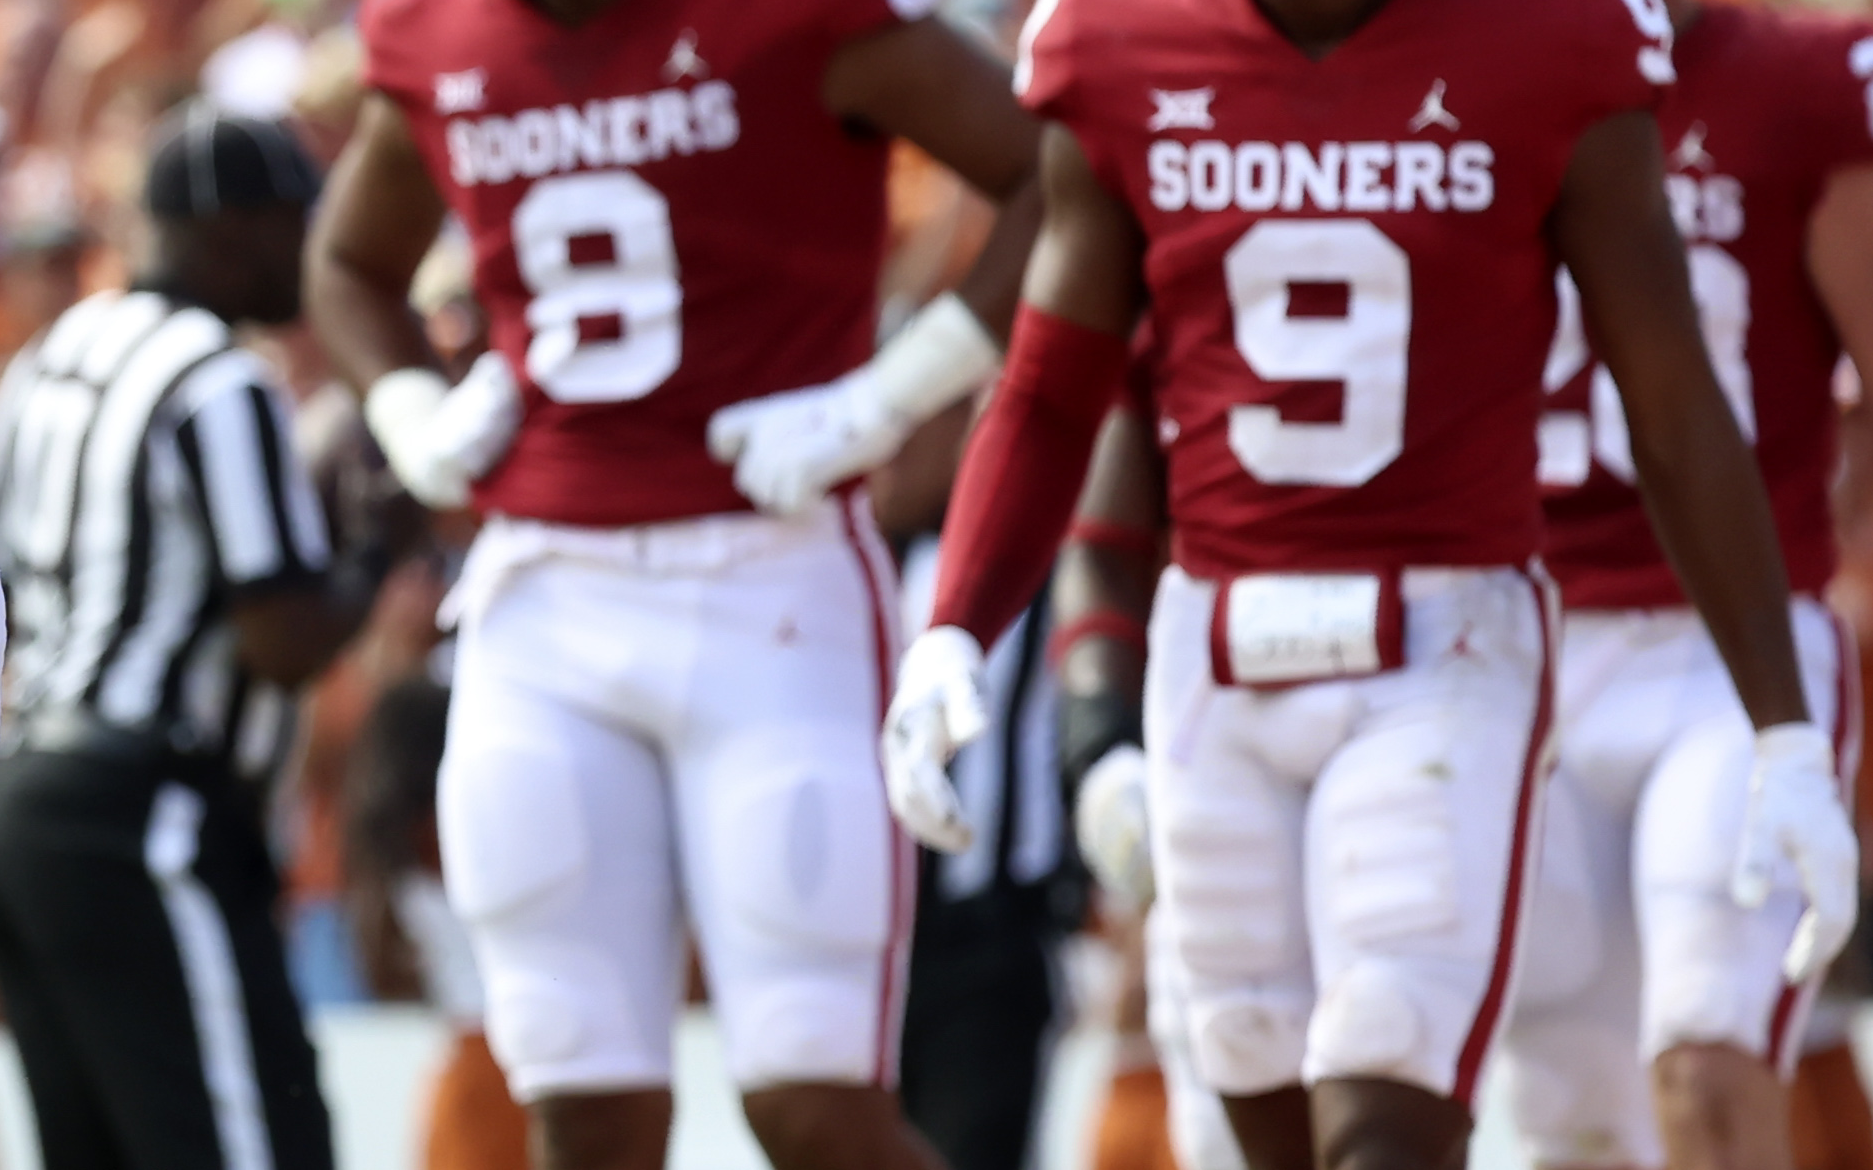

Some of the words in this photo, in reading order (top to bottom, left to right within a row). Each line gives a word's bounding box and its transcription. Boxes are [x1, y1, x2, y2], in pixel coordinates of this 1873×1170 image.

[447, 80, 739, 185] SOONERS
[1147, 141, 1494, 212] SOONERS
[511, 169, 683, 404] 8
[1223, 218, 1412, 486] 9
